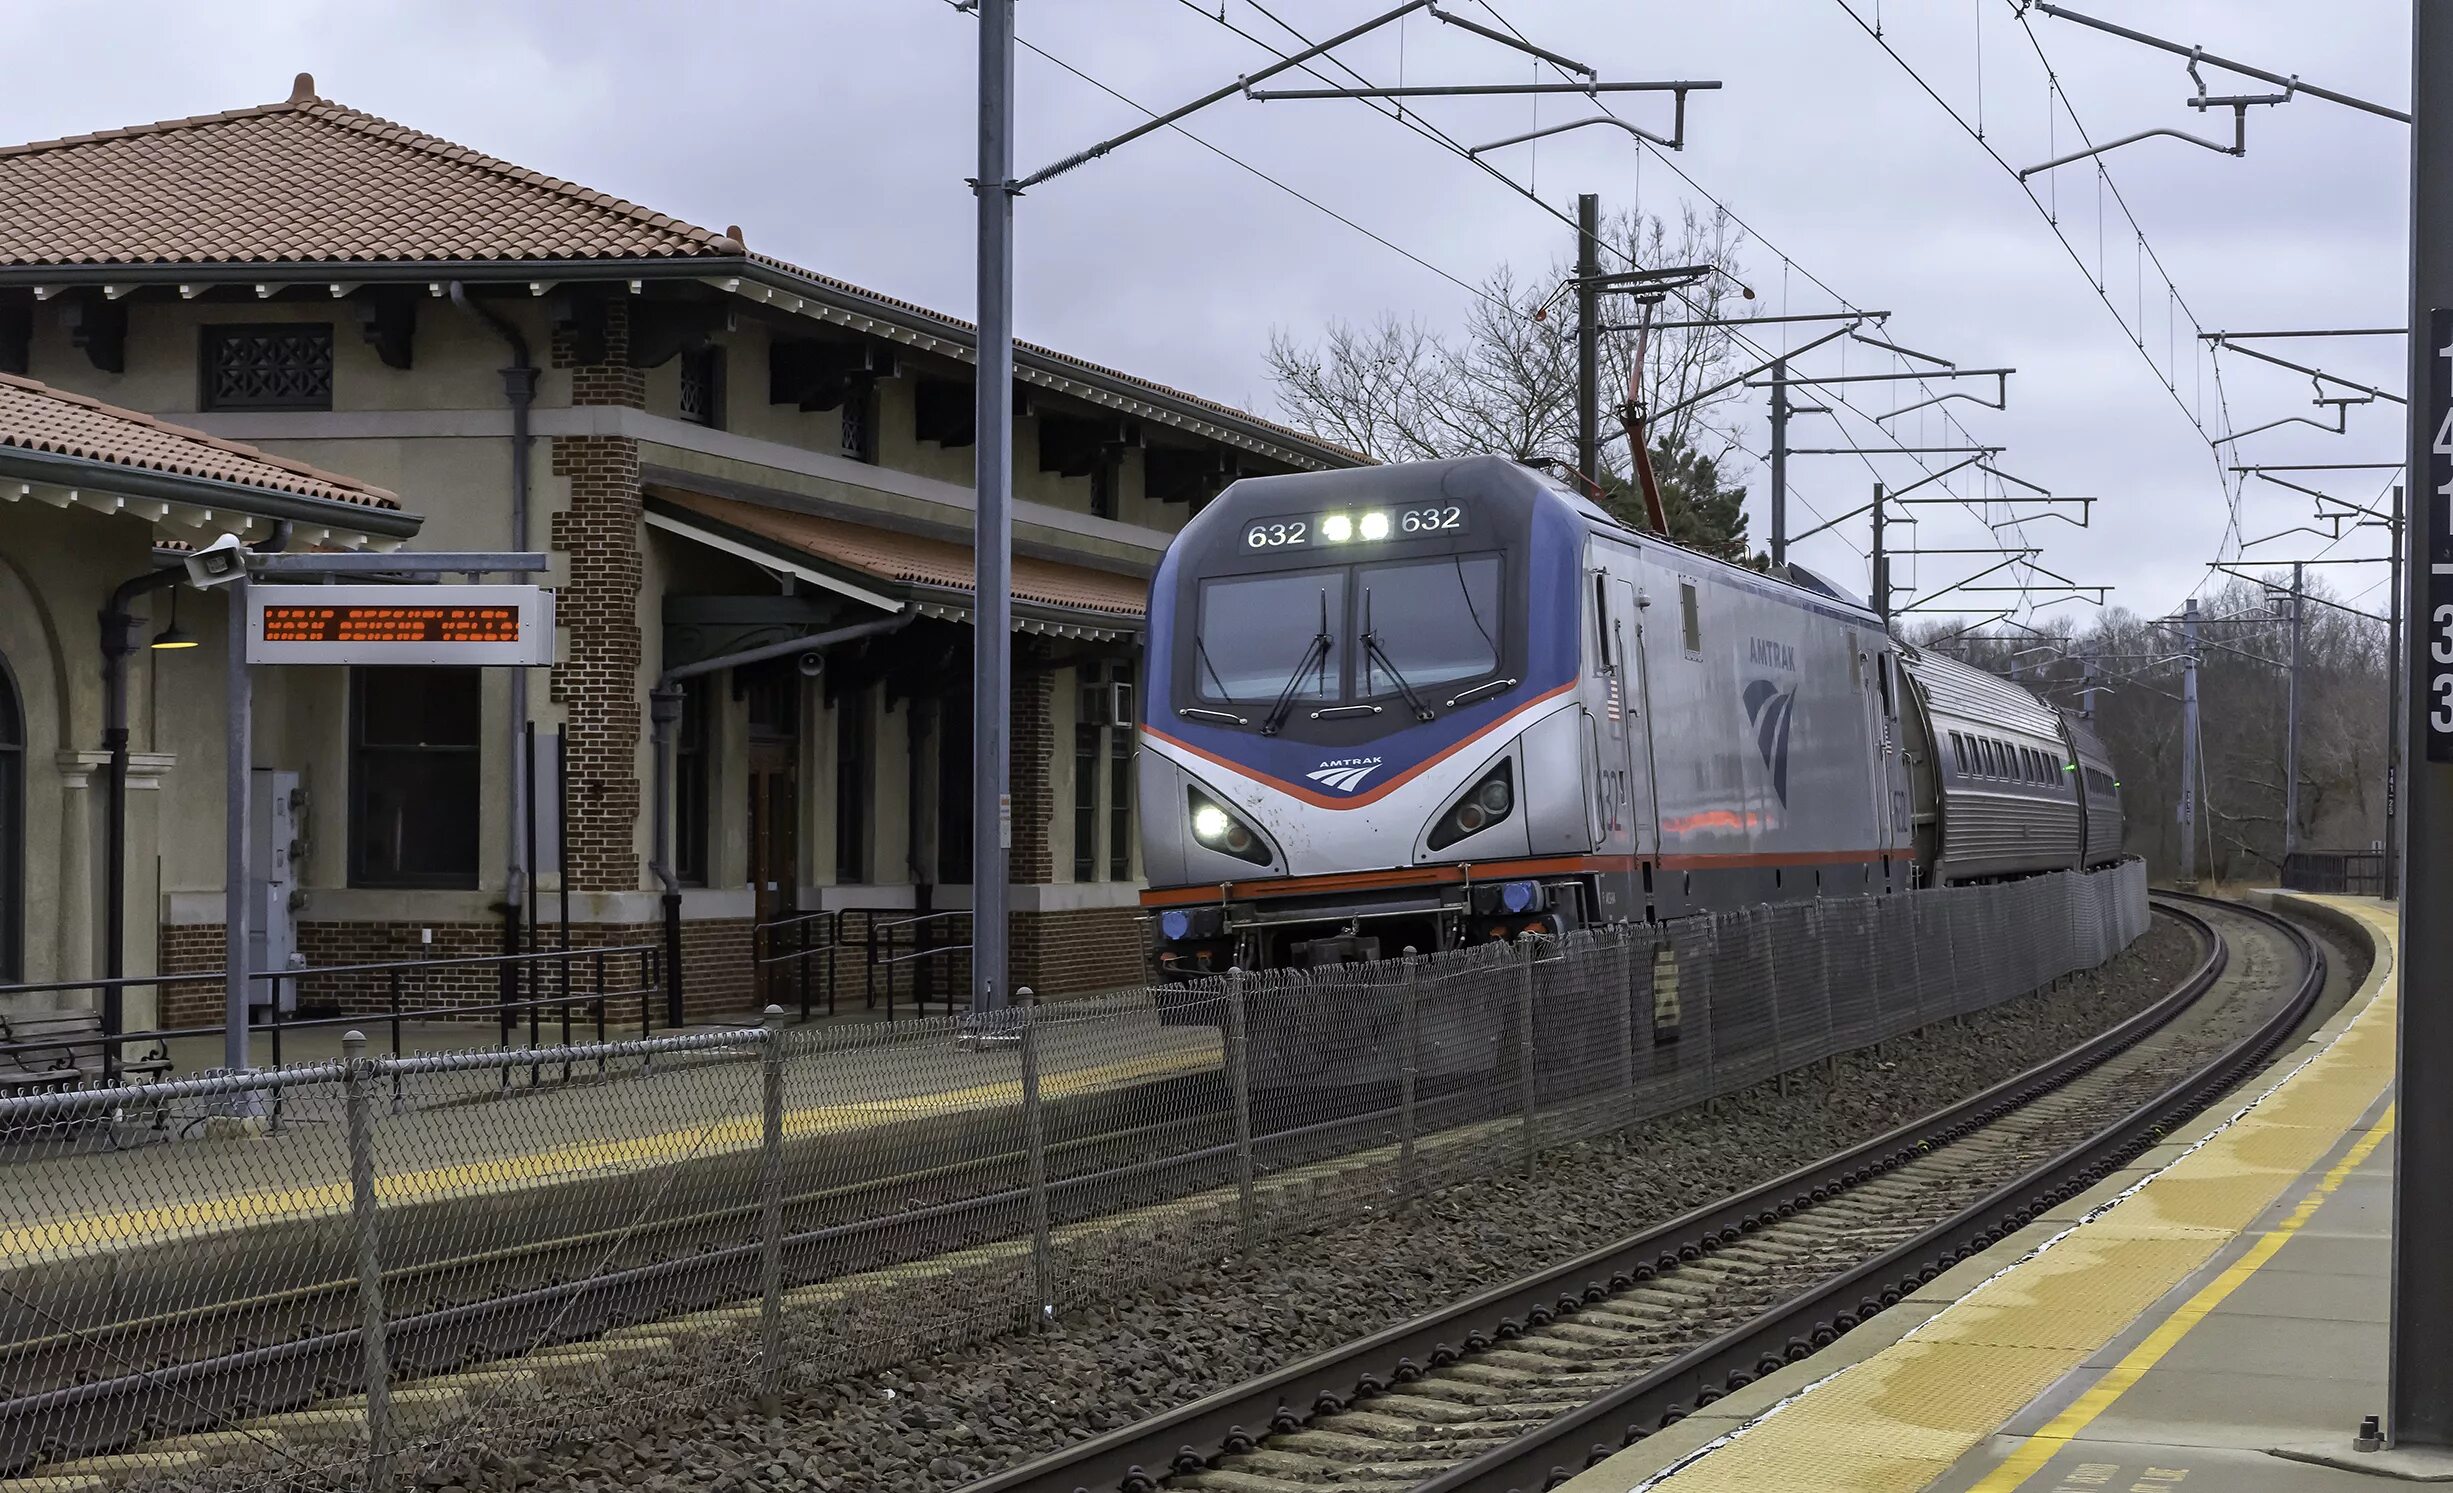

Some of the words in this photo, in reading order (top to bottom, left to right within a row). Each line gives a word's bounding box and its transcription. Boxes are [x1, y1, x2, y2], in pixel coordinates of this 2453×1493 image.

[1402, 506, 1461, 533] 632
[1248, 523, 1306, 548] 632
[1750, 636, 1796, 672] AMTRAK
[1319, 756, 1382, 768] AMTRAK
